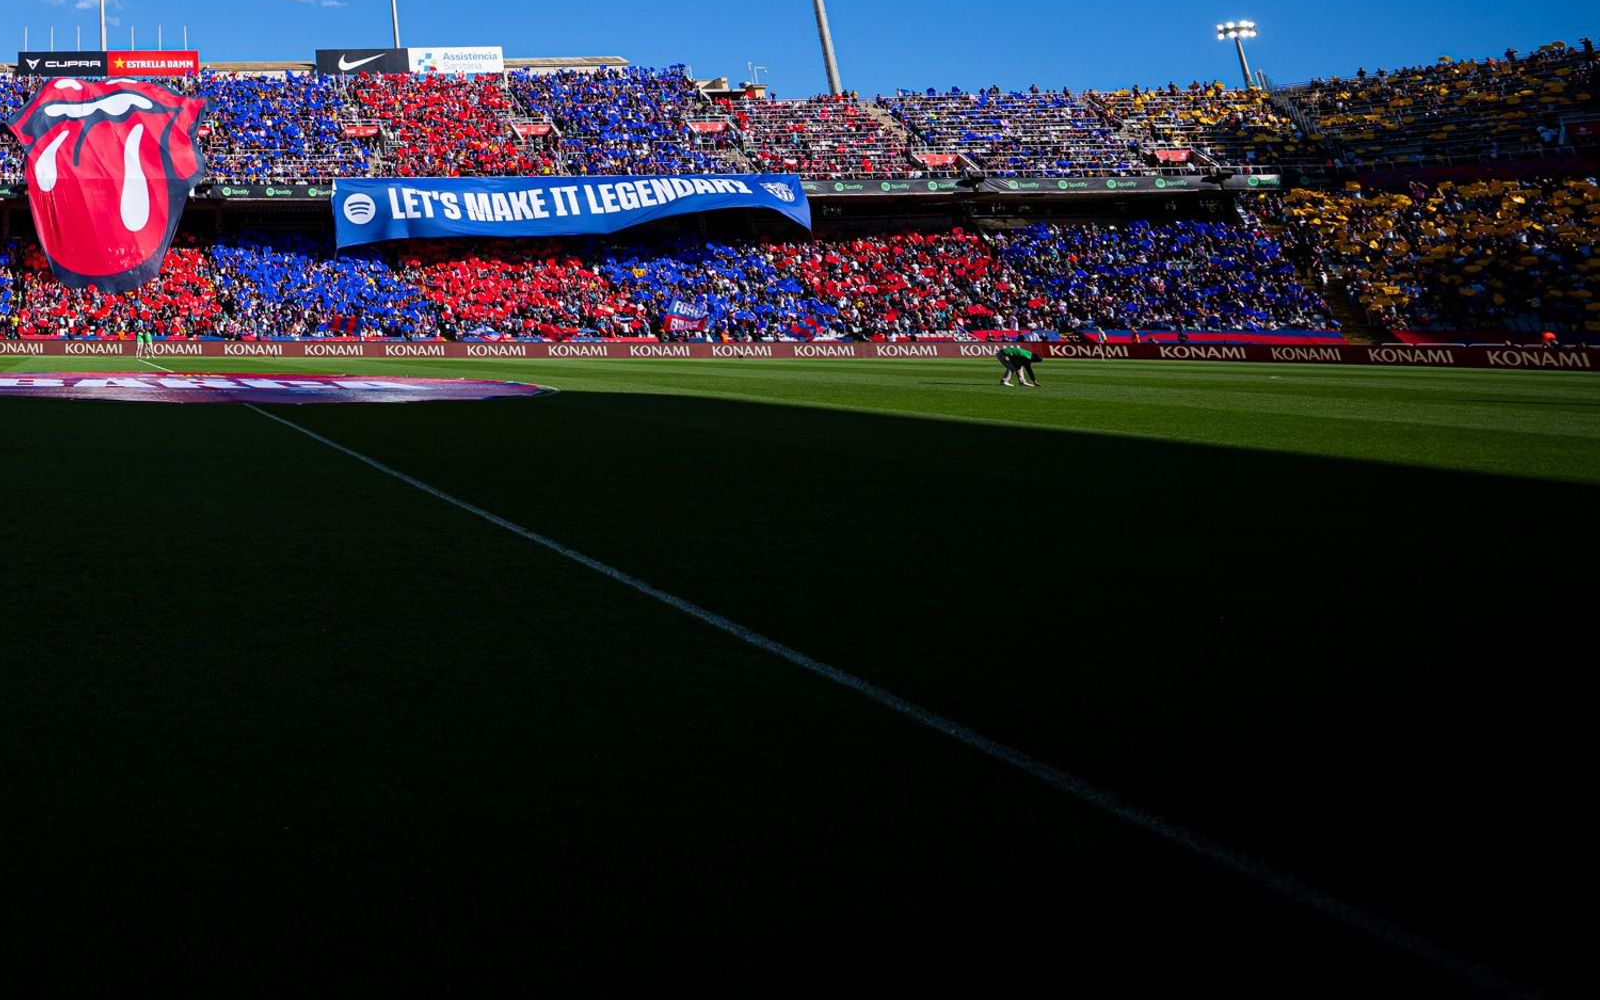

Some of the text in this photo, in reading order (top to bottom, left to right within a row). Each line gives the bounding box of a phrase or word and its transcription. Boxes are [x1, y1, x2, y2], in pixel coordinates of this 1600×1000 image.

[45, 60, 101, 68] CUPRA
[126, 60, 194, 68] ESTRELLA DAMM
[388, 178, 754, 221] LET'S MAKE IT LEGENDARY
[64, 342, 123, 354] KONAMI
[151, 343, 202, 355] ONAMI
[224, 344, 283, 356] KONAMI
[304, 344, 364, 356] KONAMI
[385, 345, 445, 356] KONAMI
[466, 345, 527, 357] KONAMI
[548, 345, 608, 357] KONAMI
[629, 345, 690, 357] KONAMI
[711, 345, 772, 357] KONAMI
[793, 345, 855, 357] KONAMI
[876, 345, 938, 357] KONAMI
[1050, 345, 1129, 358] KONAMI
[1159, 345, 1247, 359] KONAMI
[1271, 347, 1342, 361] KONAMI
[1368, 348, 1454, 364] KONAMI
[1486, 350, 1591, 367] KONAMI
